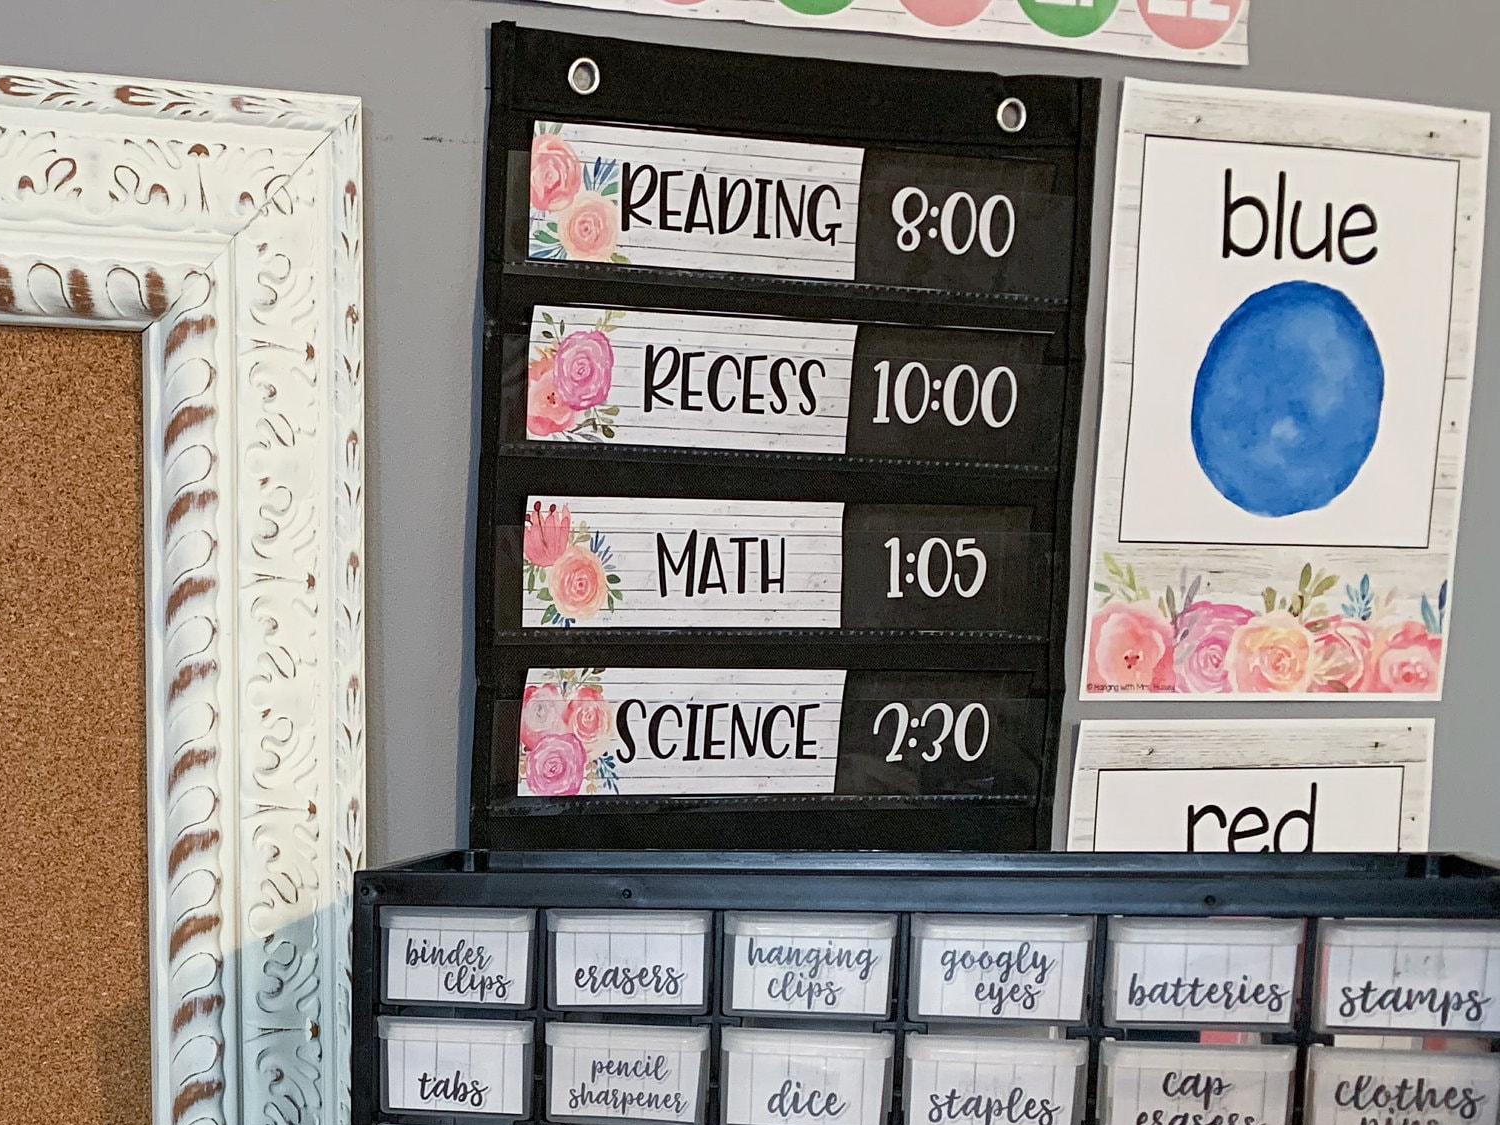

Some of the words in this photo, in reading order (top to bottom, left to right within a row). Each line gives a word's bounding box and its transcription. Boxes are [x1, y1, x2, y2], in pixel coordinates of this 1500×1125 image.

[620, 161, 842, 248] READING
[890, 185, 1017, 259] 8:00
[1221, 167, 1380, 267] blue
[643, 343, 828, 419] RECESS
[871, 359, 1019, 429] 10:00
[655, 529, 787, 599] MATH
[883, 536, 988, 599] 1:05
[615, 697, 820, 767] SCIENCE
[871, 702, 991, 763] 2:30
[1187, 782, 1317, 853] red
[405, 939, 492, 971] binder
[747, 937, 879, 982] hanging
[940, 942, 1057, 993] googly
[443, 965, 511, 999] clips
[574, 963, 685, 996] erasers
[767, 972, 843, 1009] clips
[974, 978, 1043, 1009] eyes
[1127, 973, 1290, 1009] batteries
[1338, 982, 1491, 1024] stamps
[418, 1071, 490, 1106] tabs
[591, 1054, 670, 1084] pencil
[1162, 1068, 1231, 1110] cap
[568, 1086, 688, 1115] sharpener
[767, 1079, 847, 1118] dice
[1334, 1075, 1485, 1120] clothes
